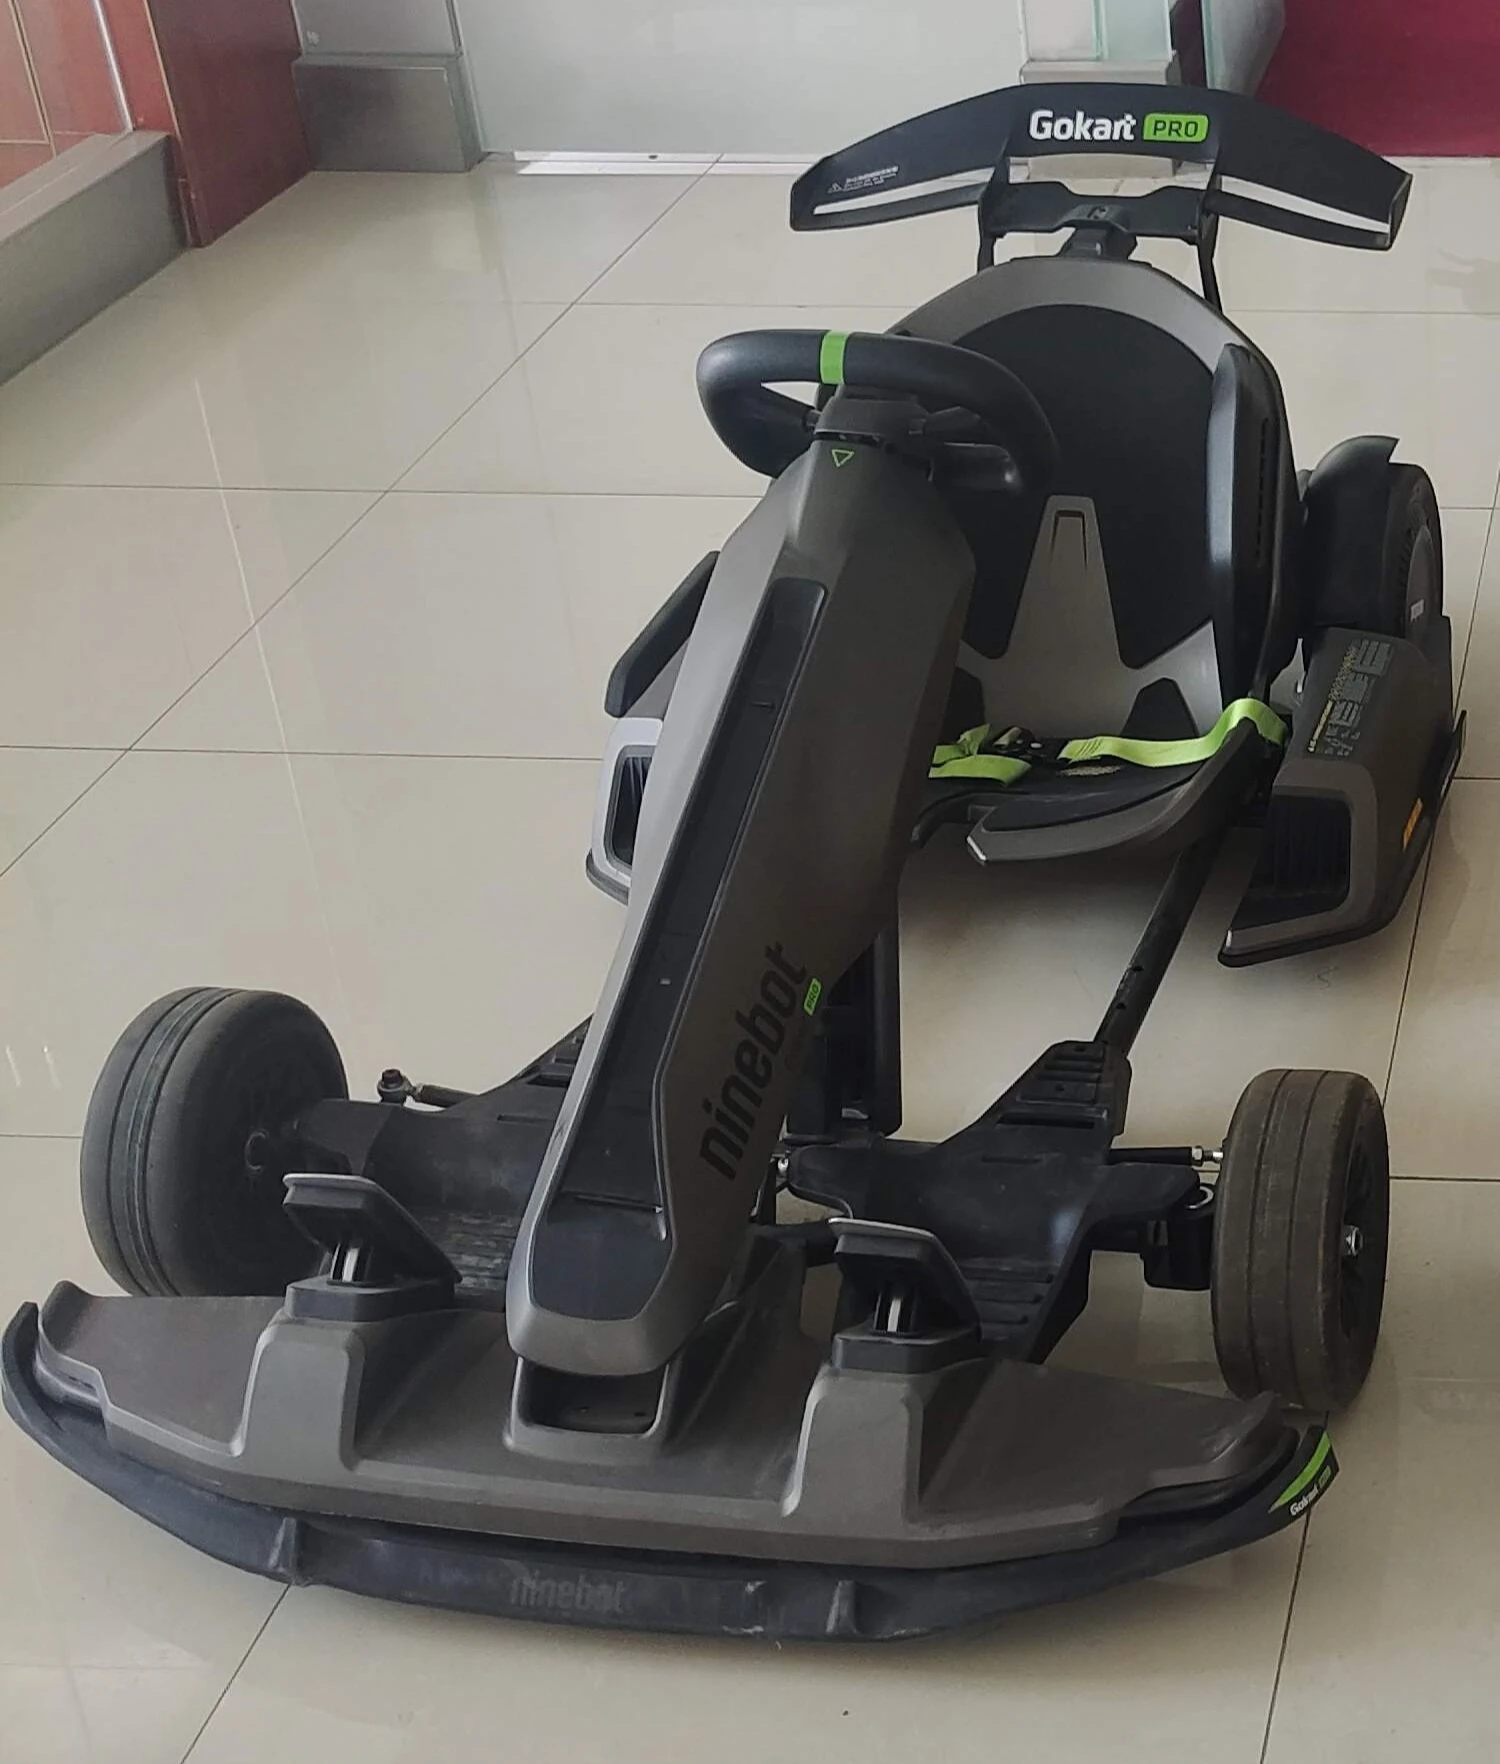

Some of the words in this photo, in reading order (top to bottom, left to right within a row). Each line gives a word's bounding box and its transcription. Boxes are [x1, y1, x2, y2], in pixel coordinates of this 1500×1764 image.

[1029, 109, 1137, 141] Gokart
[1153, 120, 1199, 138] PRO
[699, 941, 807, 1182] ninebot
[509, 1569, 626, 1613] ninebot
